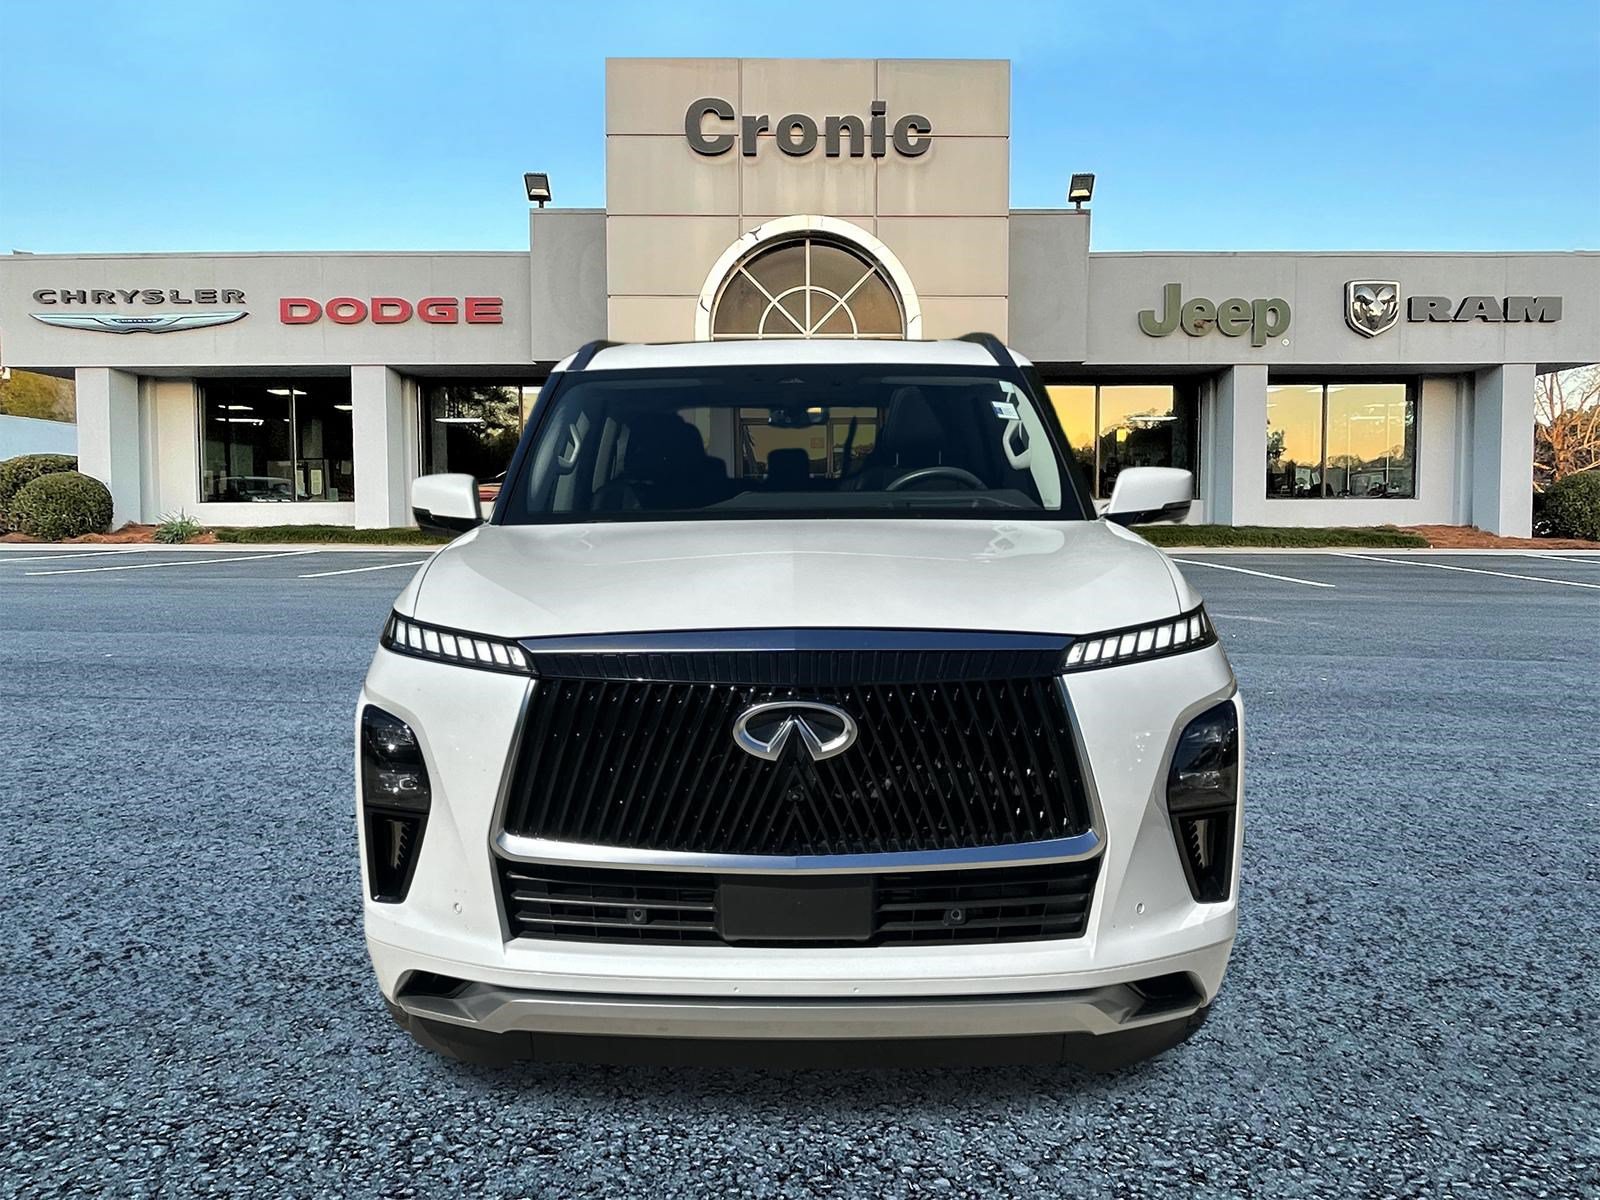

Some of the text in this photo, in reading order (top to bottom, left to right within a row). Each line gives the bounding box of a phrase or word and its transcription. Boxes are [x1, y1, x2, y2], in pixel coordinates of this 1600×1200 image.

[685, 98, 932, 157] Cronic
[32, 288, 246, 305] CHRYSLER
[1408, 296, 1562, 322] RAM
[280, 297, 503, 325] DODGE
[1138, 283, 1291, 347] Jeep
